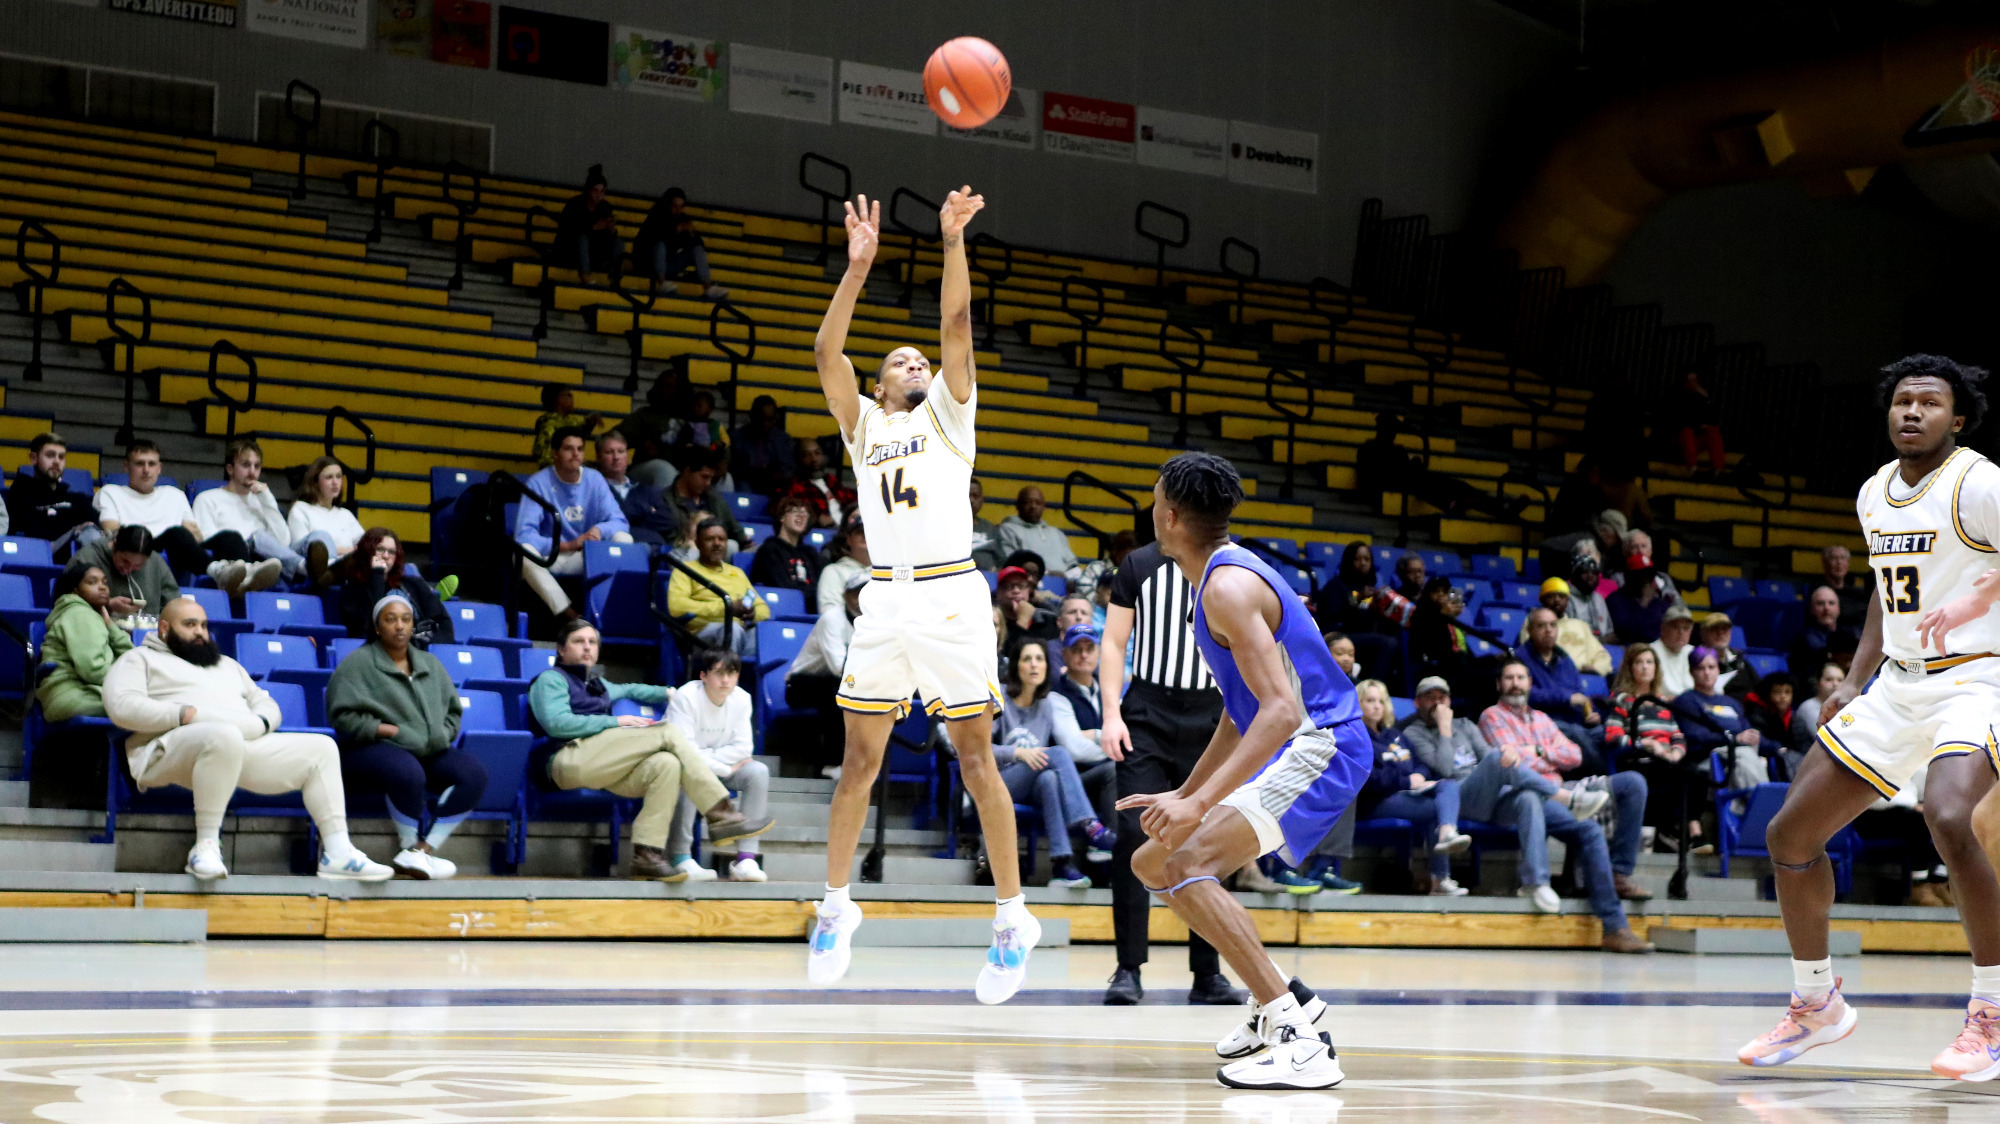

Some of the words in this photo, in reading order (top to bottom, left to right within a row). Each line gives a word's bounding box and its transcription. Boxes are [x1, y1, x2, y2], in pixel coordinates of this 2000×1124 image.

[639, 72, 667, 83] EVENT
[666, 77, 699, 88] CENTER
[843, 82, 863, 94] PIE
[866, 84, 893, 100] FIVE
[897, 91, 929, 105] PIZZ
[1060, 136, 1093, 154] Davis
[1246, 146, 1312, 171] Dewberry
[881, 467, 918, 514] 14
[1870, 530, 1937, 556] AVERETT
[1881, 566, 1920, 613] 33
